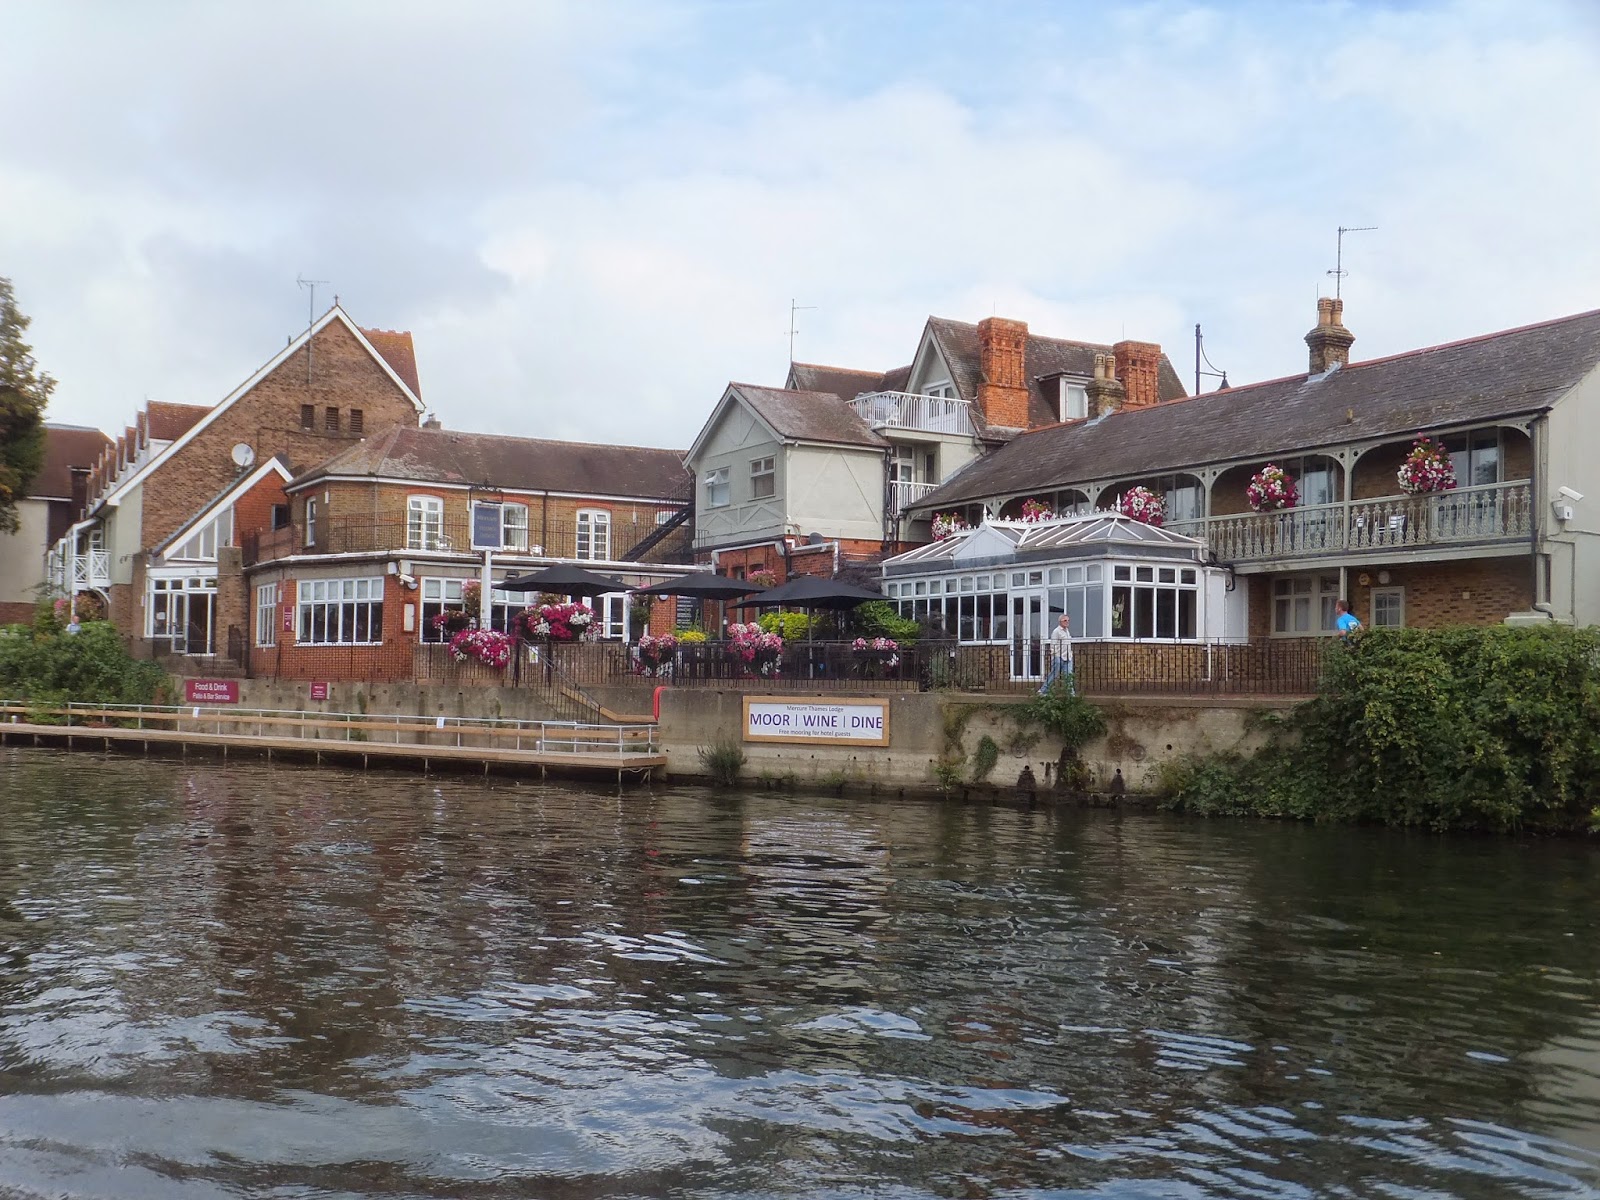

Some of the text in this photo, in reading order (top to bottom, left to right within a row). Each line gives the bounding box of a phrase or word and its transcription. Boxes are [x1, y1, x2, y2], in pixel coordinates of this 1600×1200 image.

[750, 714, 882, 728] MOOR WINE DINE
